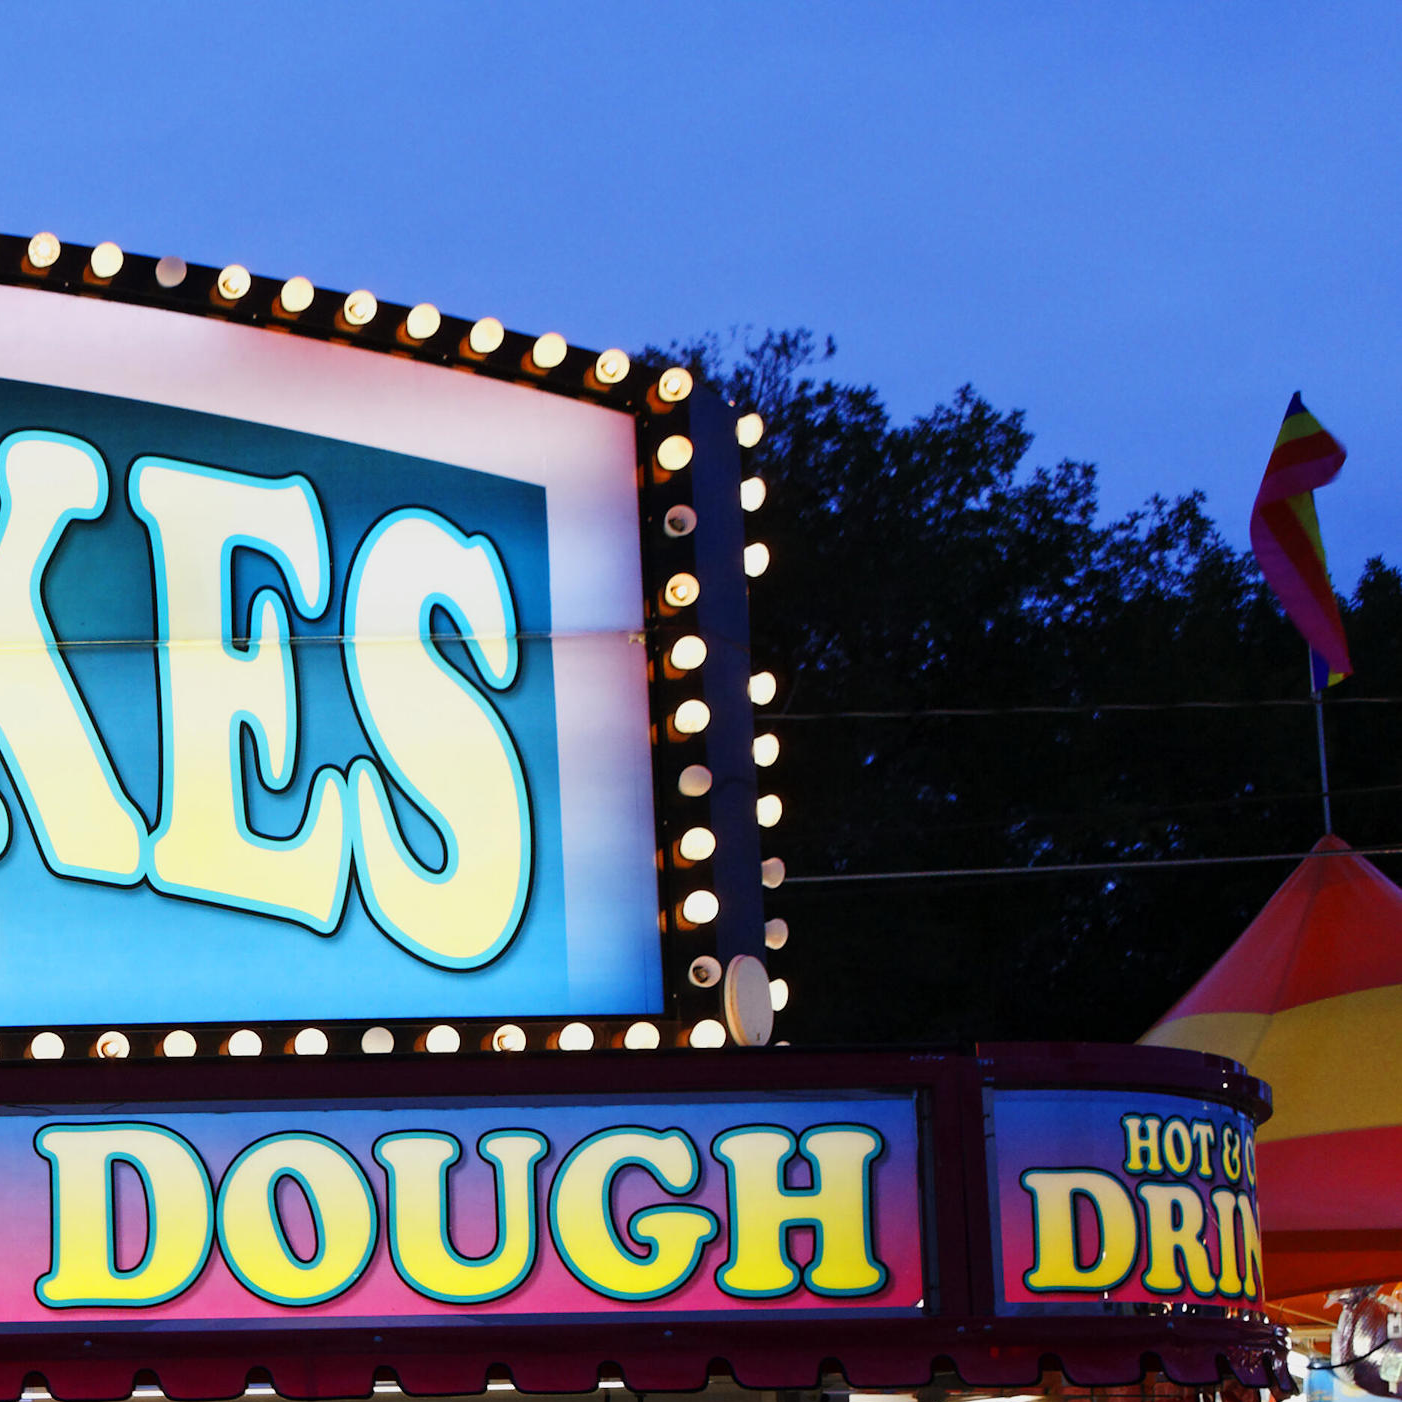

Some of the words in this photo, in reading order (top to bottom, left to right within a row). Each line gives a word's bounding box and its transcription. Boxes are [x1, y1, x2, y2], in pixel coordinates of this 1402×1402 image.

[1121, 1112, 1215, 1180] HOT
[1222, 1121, 1241, 1184] &
[36, 1120, 886, 1310] DOUGH
